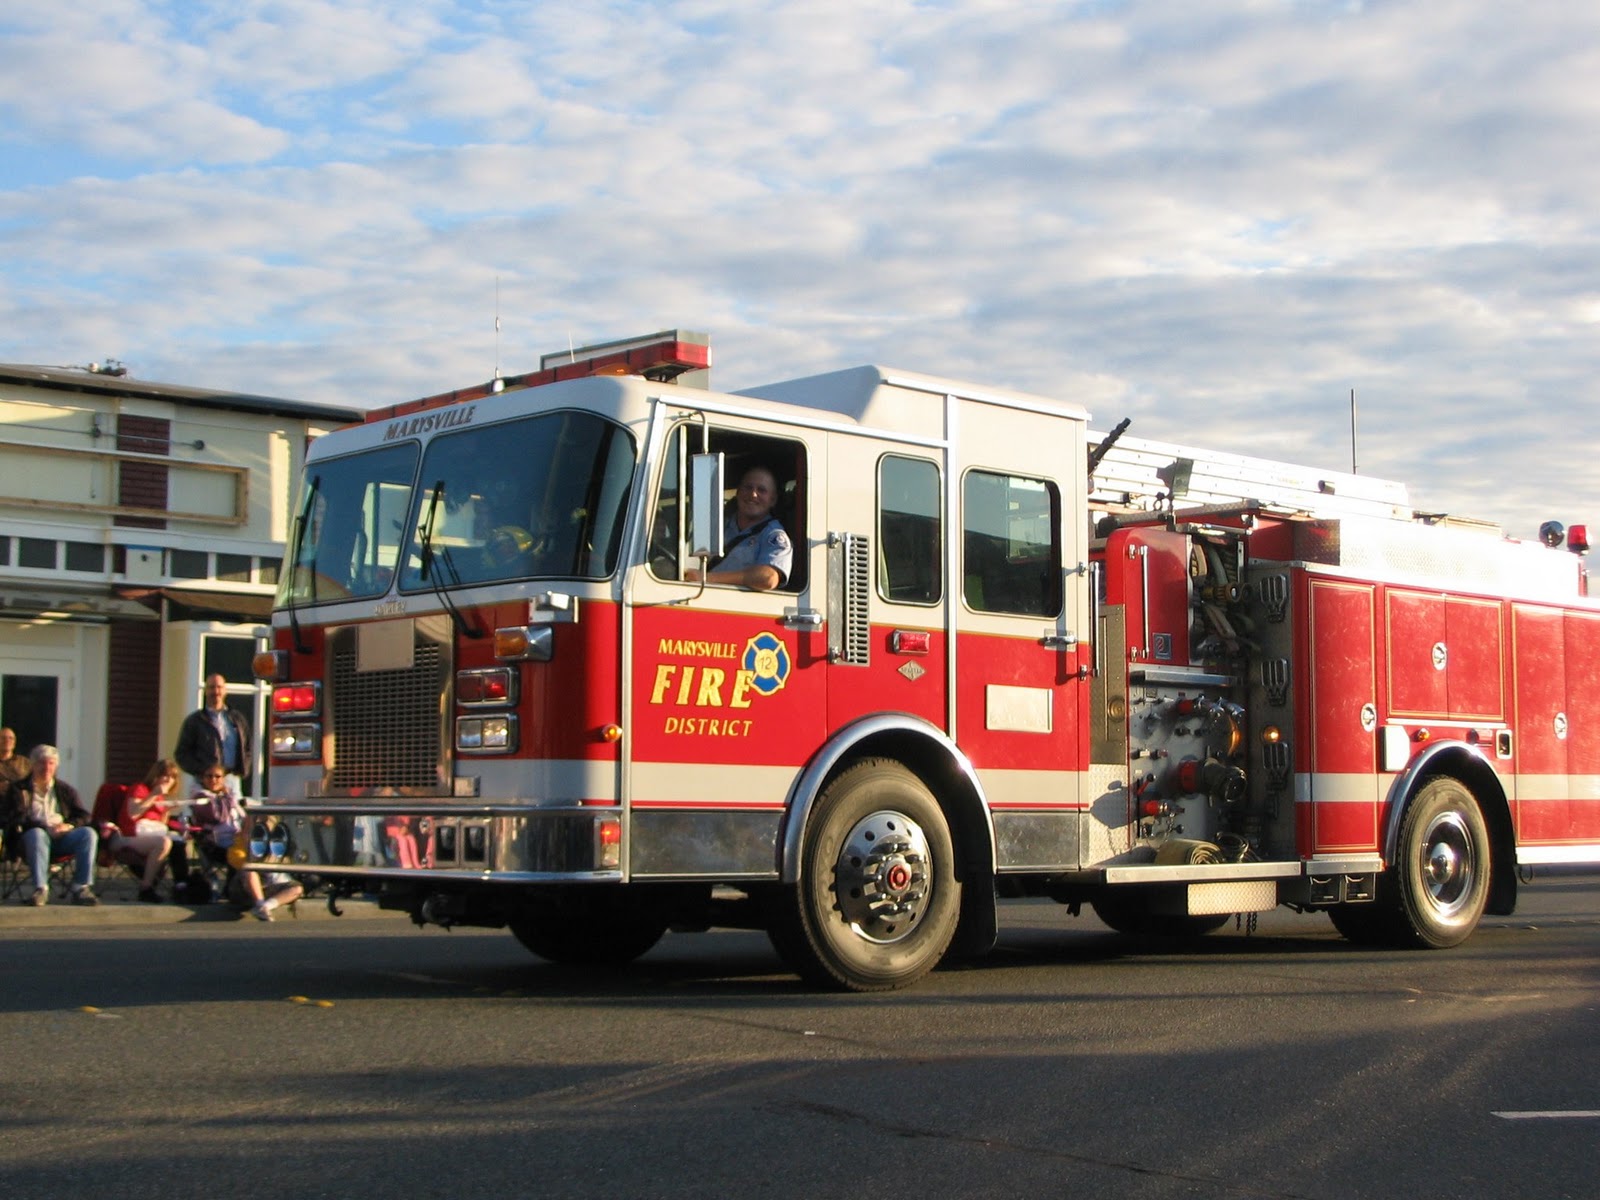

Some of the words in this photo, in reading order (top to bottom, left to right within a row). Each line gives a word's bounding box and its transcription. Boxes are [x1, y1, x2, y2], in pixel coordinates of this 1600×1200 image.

[383, 406, 476, 441] MARYSVILLE
[658, 638, 738, 659] MARYSVILLE
[760, 656, 772, 670] 12
[649, 664, 755, 709] FIRE
[664, 717, 753, 737] DISTRICT
